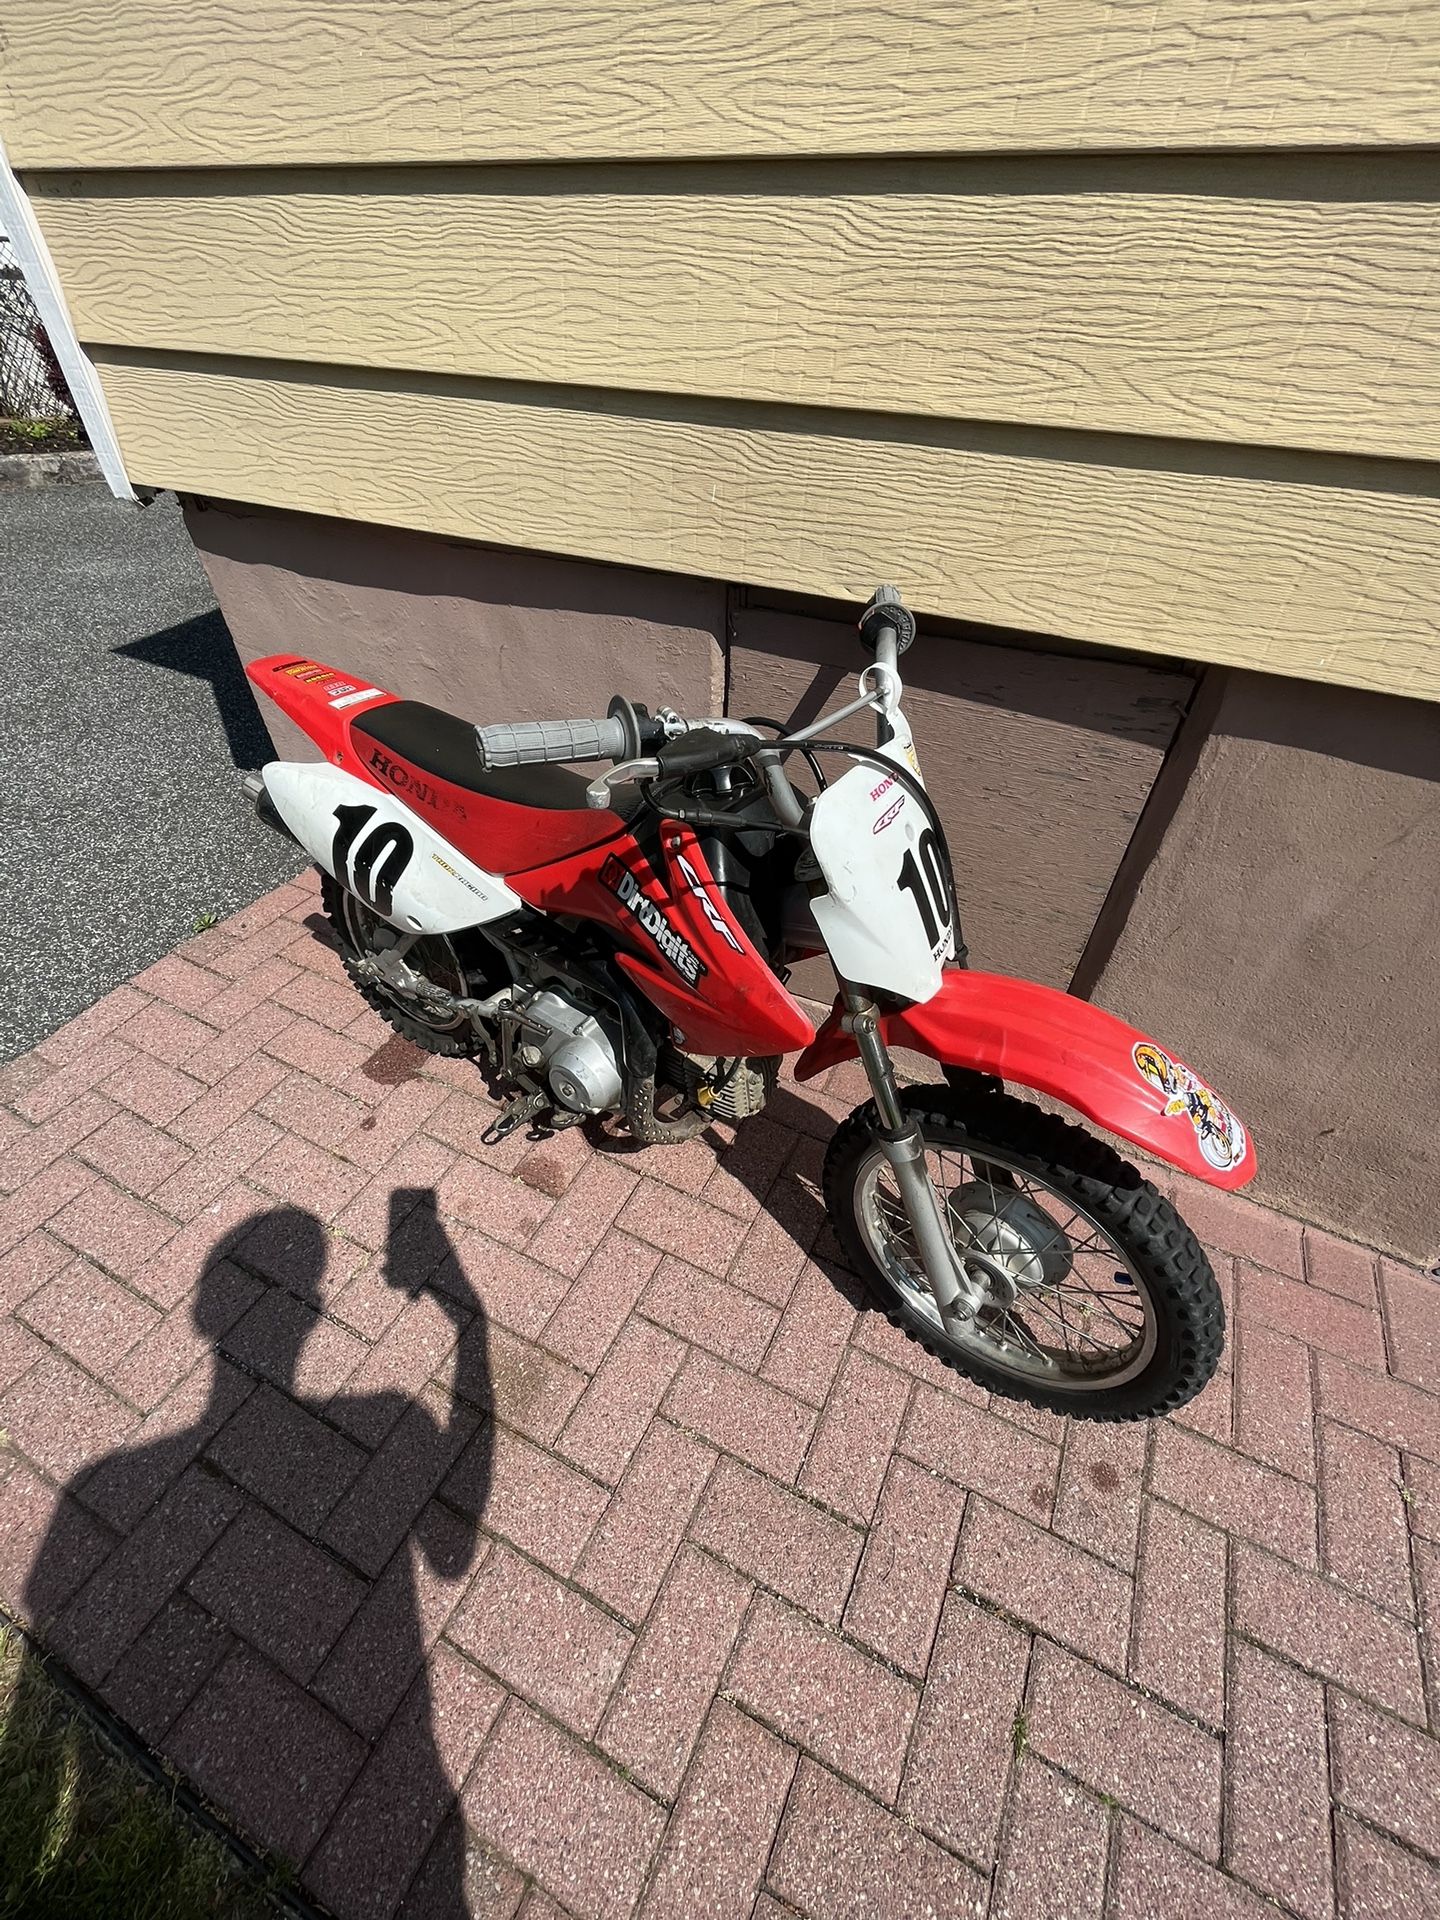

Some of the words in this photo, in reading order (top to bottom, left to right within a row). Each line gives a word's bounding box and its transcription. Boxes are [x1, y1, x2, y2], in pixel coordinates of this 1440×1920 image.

[332, 804, 414, 917] 10
[677, 855, 744, 954] CRF
[897, 828, 951, 950] 10
[617, 871, 699, 981] DirtDigits
